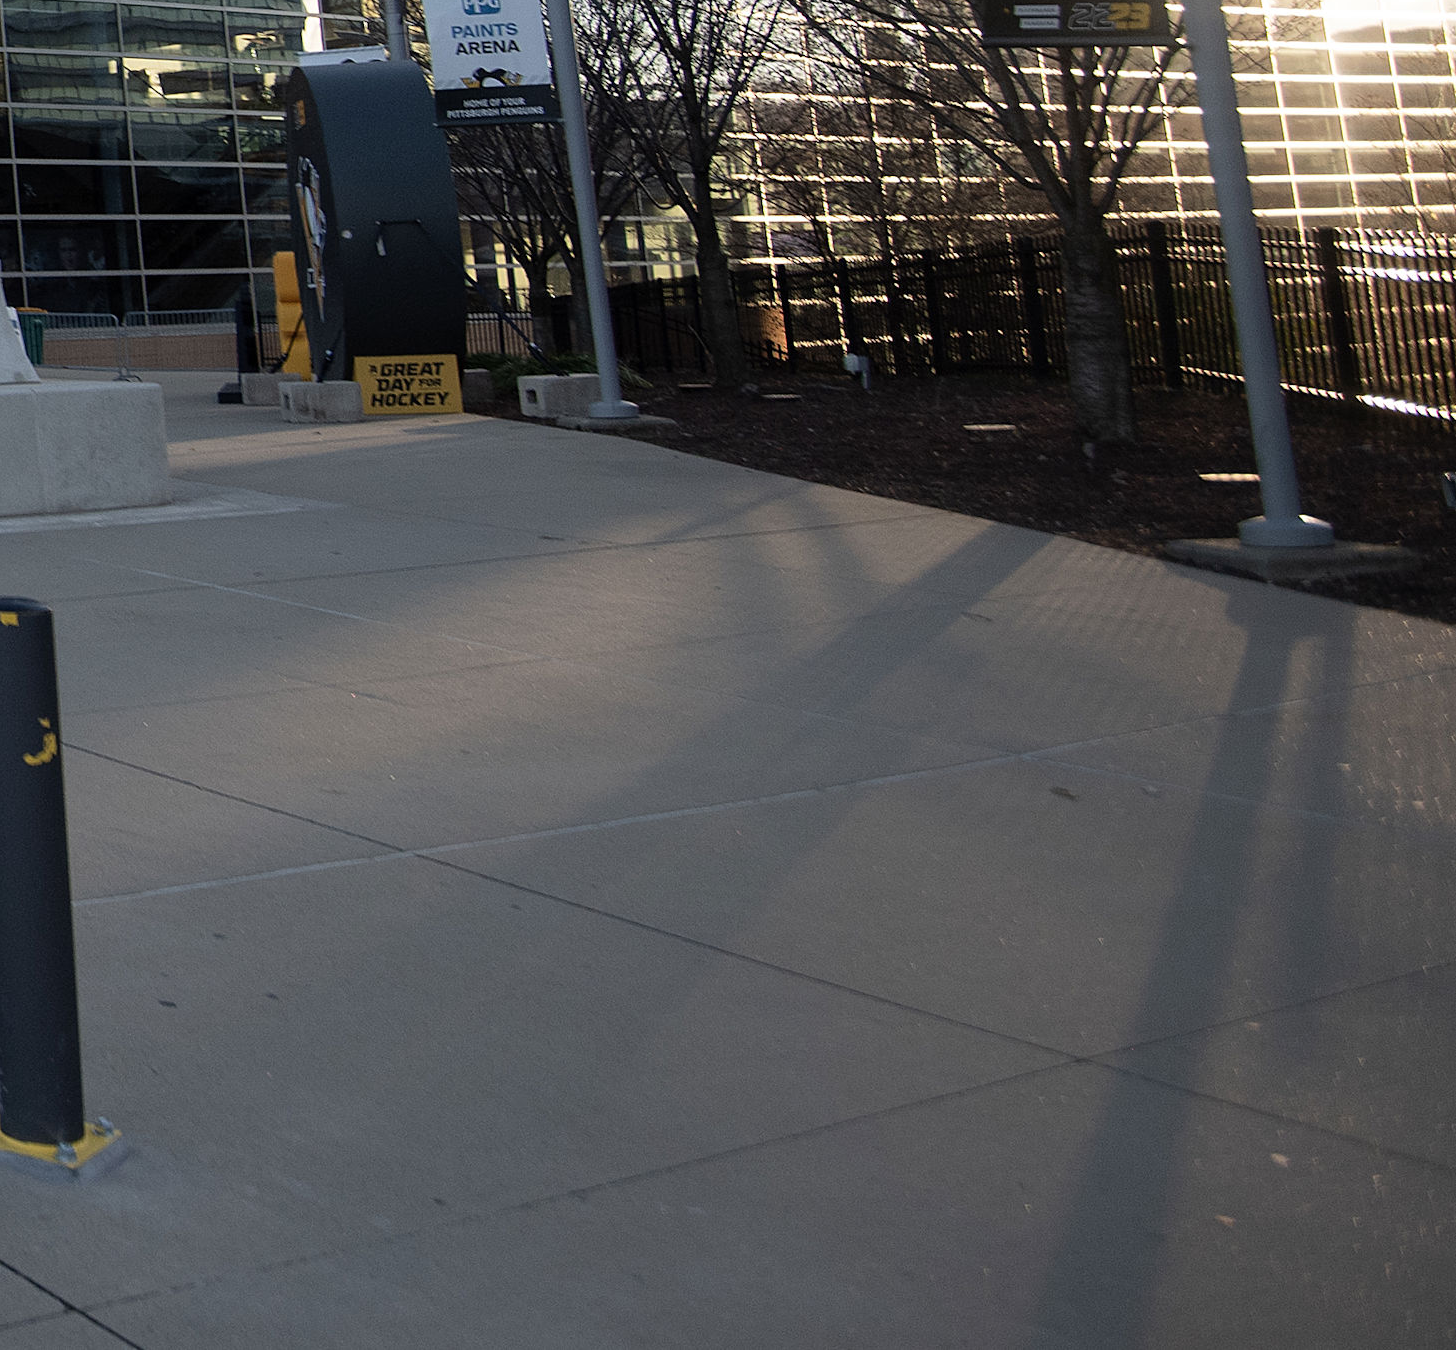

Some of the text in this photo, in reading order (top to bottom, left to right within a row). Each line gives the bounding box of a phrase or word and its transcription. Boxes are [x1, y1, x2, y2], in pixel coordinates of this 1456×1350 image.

[451, 22, 519, 39] PAINTS
[455, 39, 521, 56] ARENA
[380, 361, 445, 377] GREAT
[376, 378, 442, 391] DAY FOR
[371, 392, 449, 407] HOCKEY
